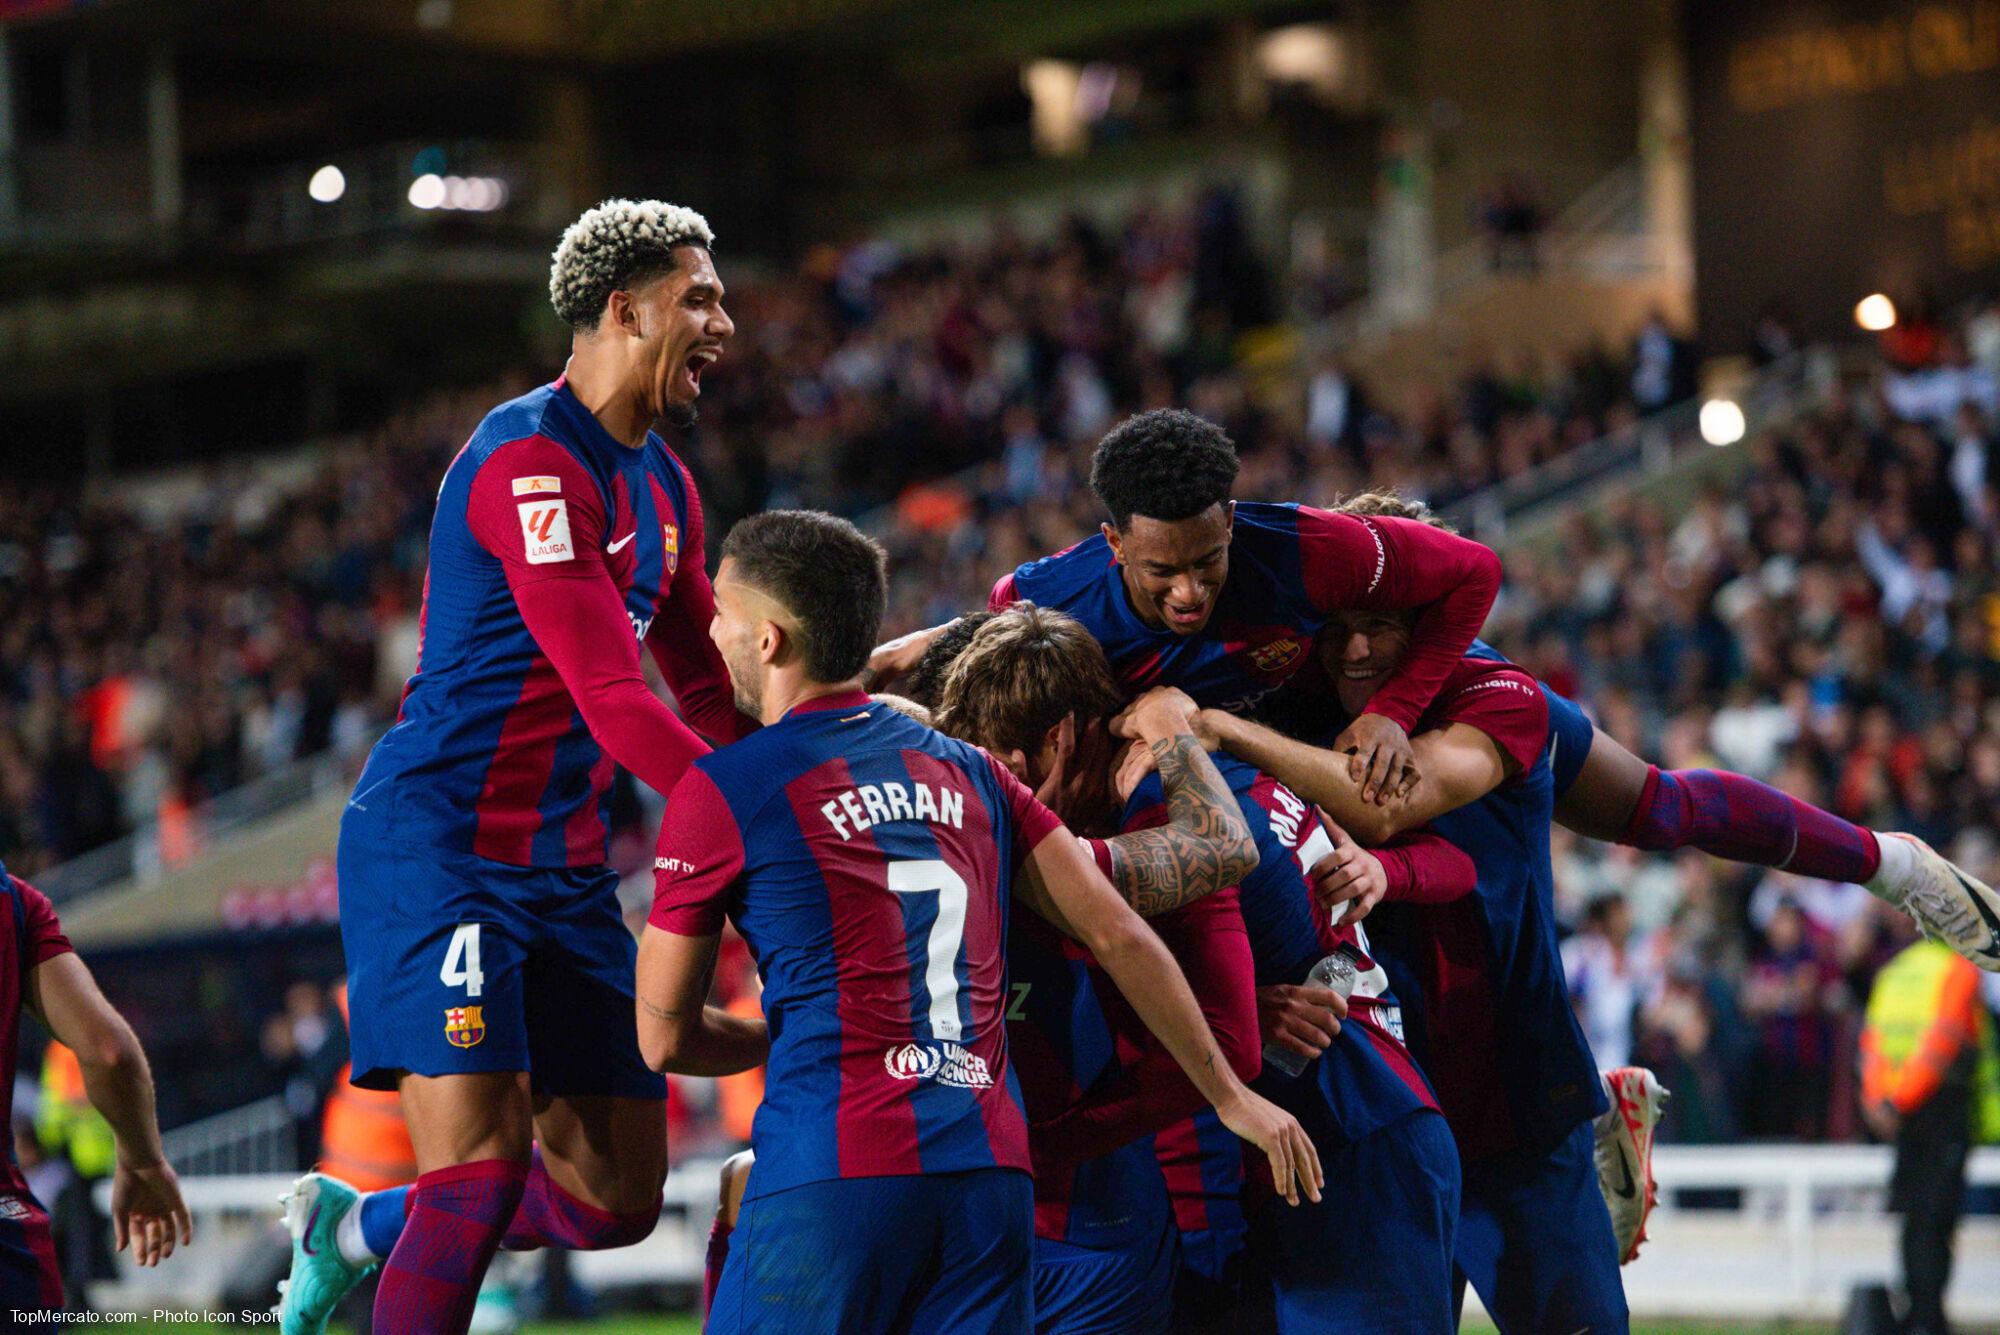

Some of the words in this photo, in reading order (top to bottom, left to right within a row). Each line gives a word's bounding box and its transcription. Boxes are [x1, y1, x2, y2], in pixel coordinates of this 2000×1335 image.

[532, 543, 567, 556] LALIGA
[821, 782, 963, 841] FERRAN
[440, 923, 484, 997] 4
[887, 860, 967, 1040] 7
[939, 1060, 994, 1084] ACNUR
[942, 1041, 988, 1073] UNHCR
